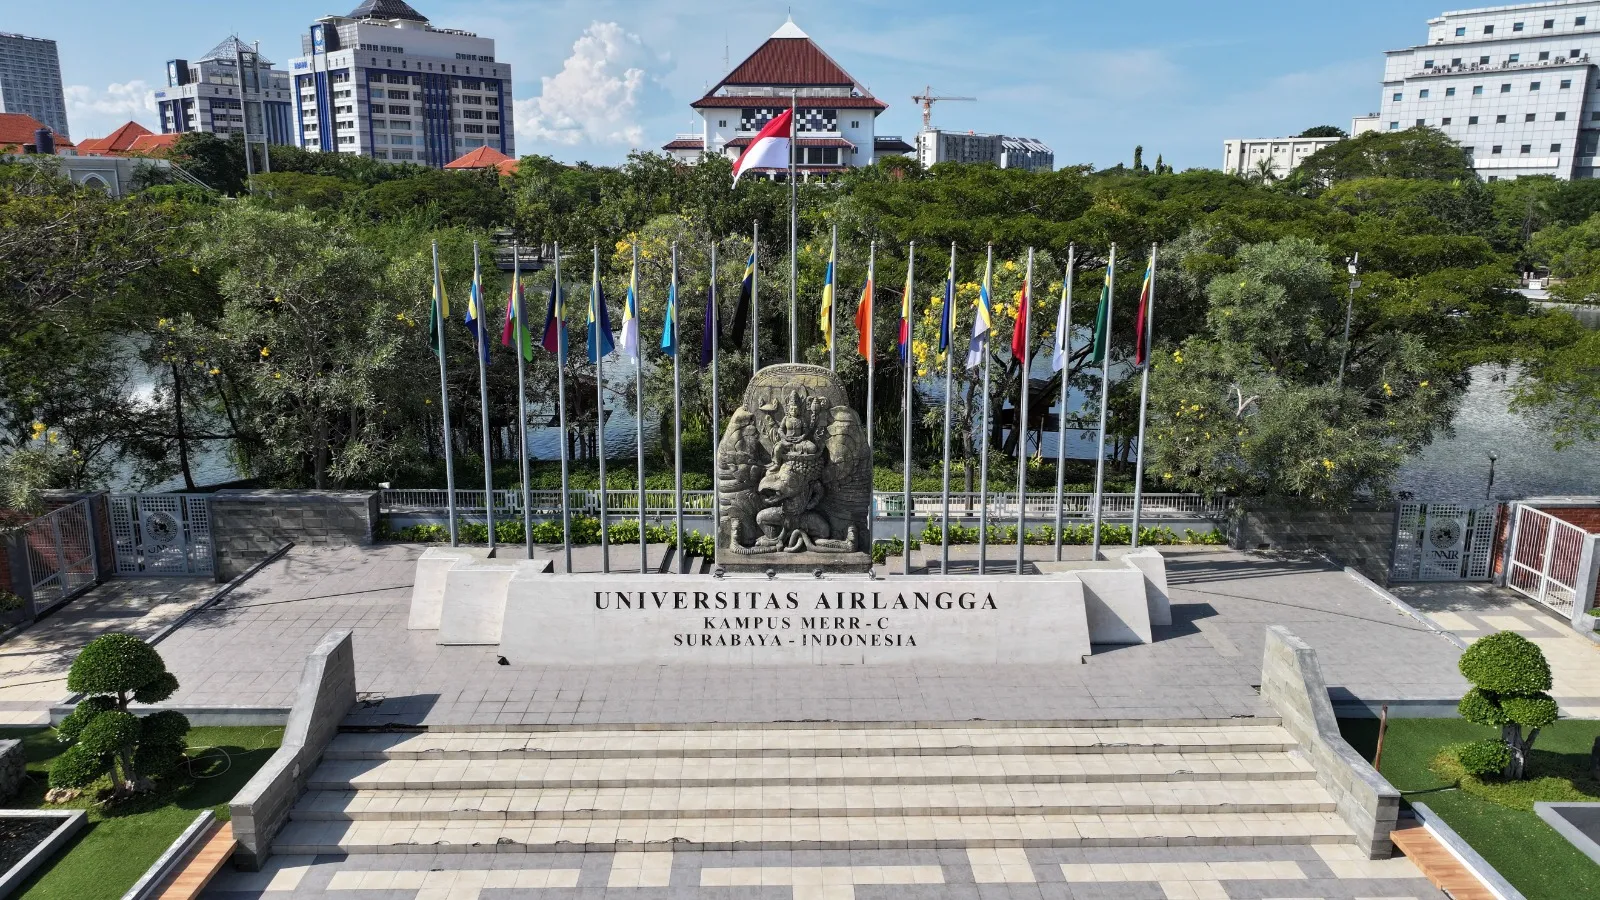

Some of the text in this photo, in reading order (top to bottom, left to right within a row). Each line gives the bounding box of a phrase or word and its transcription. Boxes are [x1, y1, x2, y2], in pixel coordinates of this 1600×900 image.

[594, 591, 998, 610] UNIVERSITAS AIRLANGGA
[704, 616, 791, 630] KAMPUS
